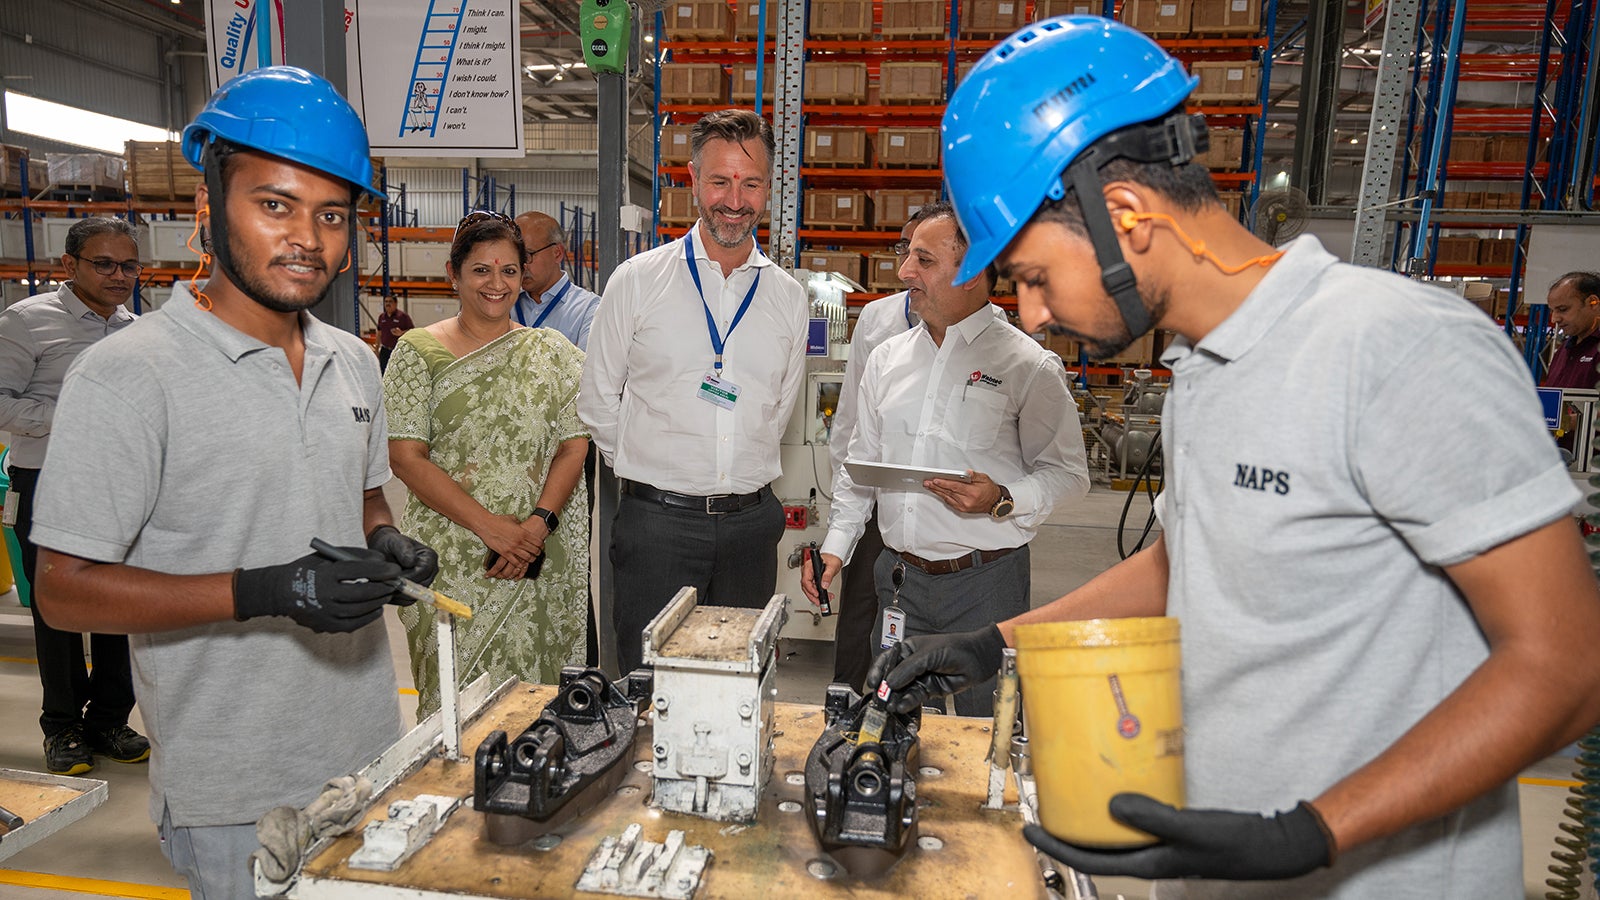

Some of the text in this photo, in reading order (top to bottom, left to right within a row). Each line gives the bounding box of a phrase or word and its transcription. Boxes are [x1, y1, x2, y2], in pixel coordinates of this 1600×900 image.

[467, 9, 486, 17] Think
[486, 9, 491, 17] I
[467, 26, 488, 35] might.
[221, 12, 247, 69] Quality
[484, 42, 506, 51] might.
[456, 58, 492, 66] What is it?
[452, 74, 497, 82] I wish I could.
[447, 122, 466, 130] won't.
[1234, 463, 1290, 496] NAPS
